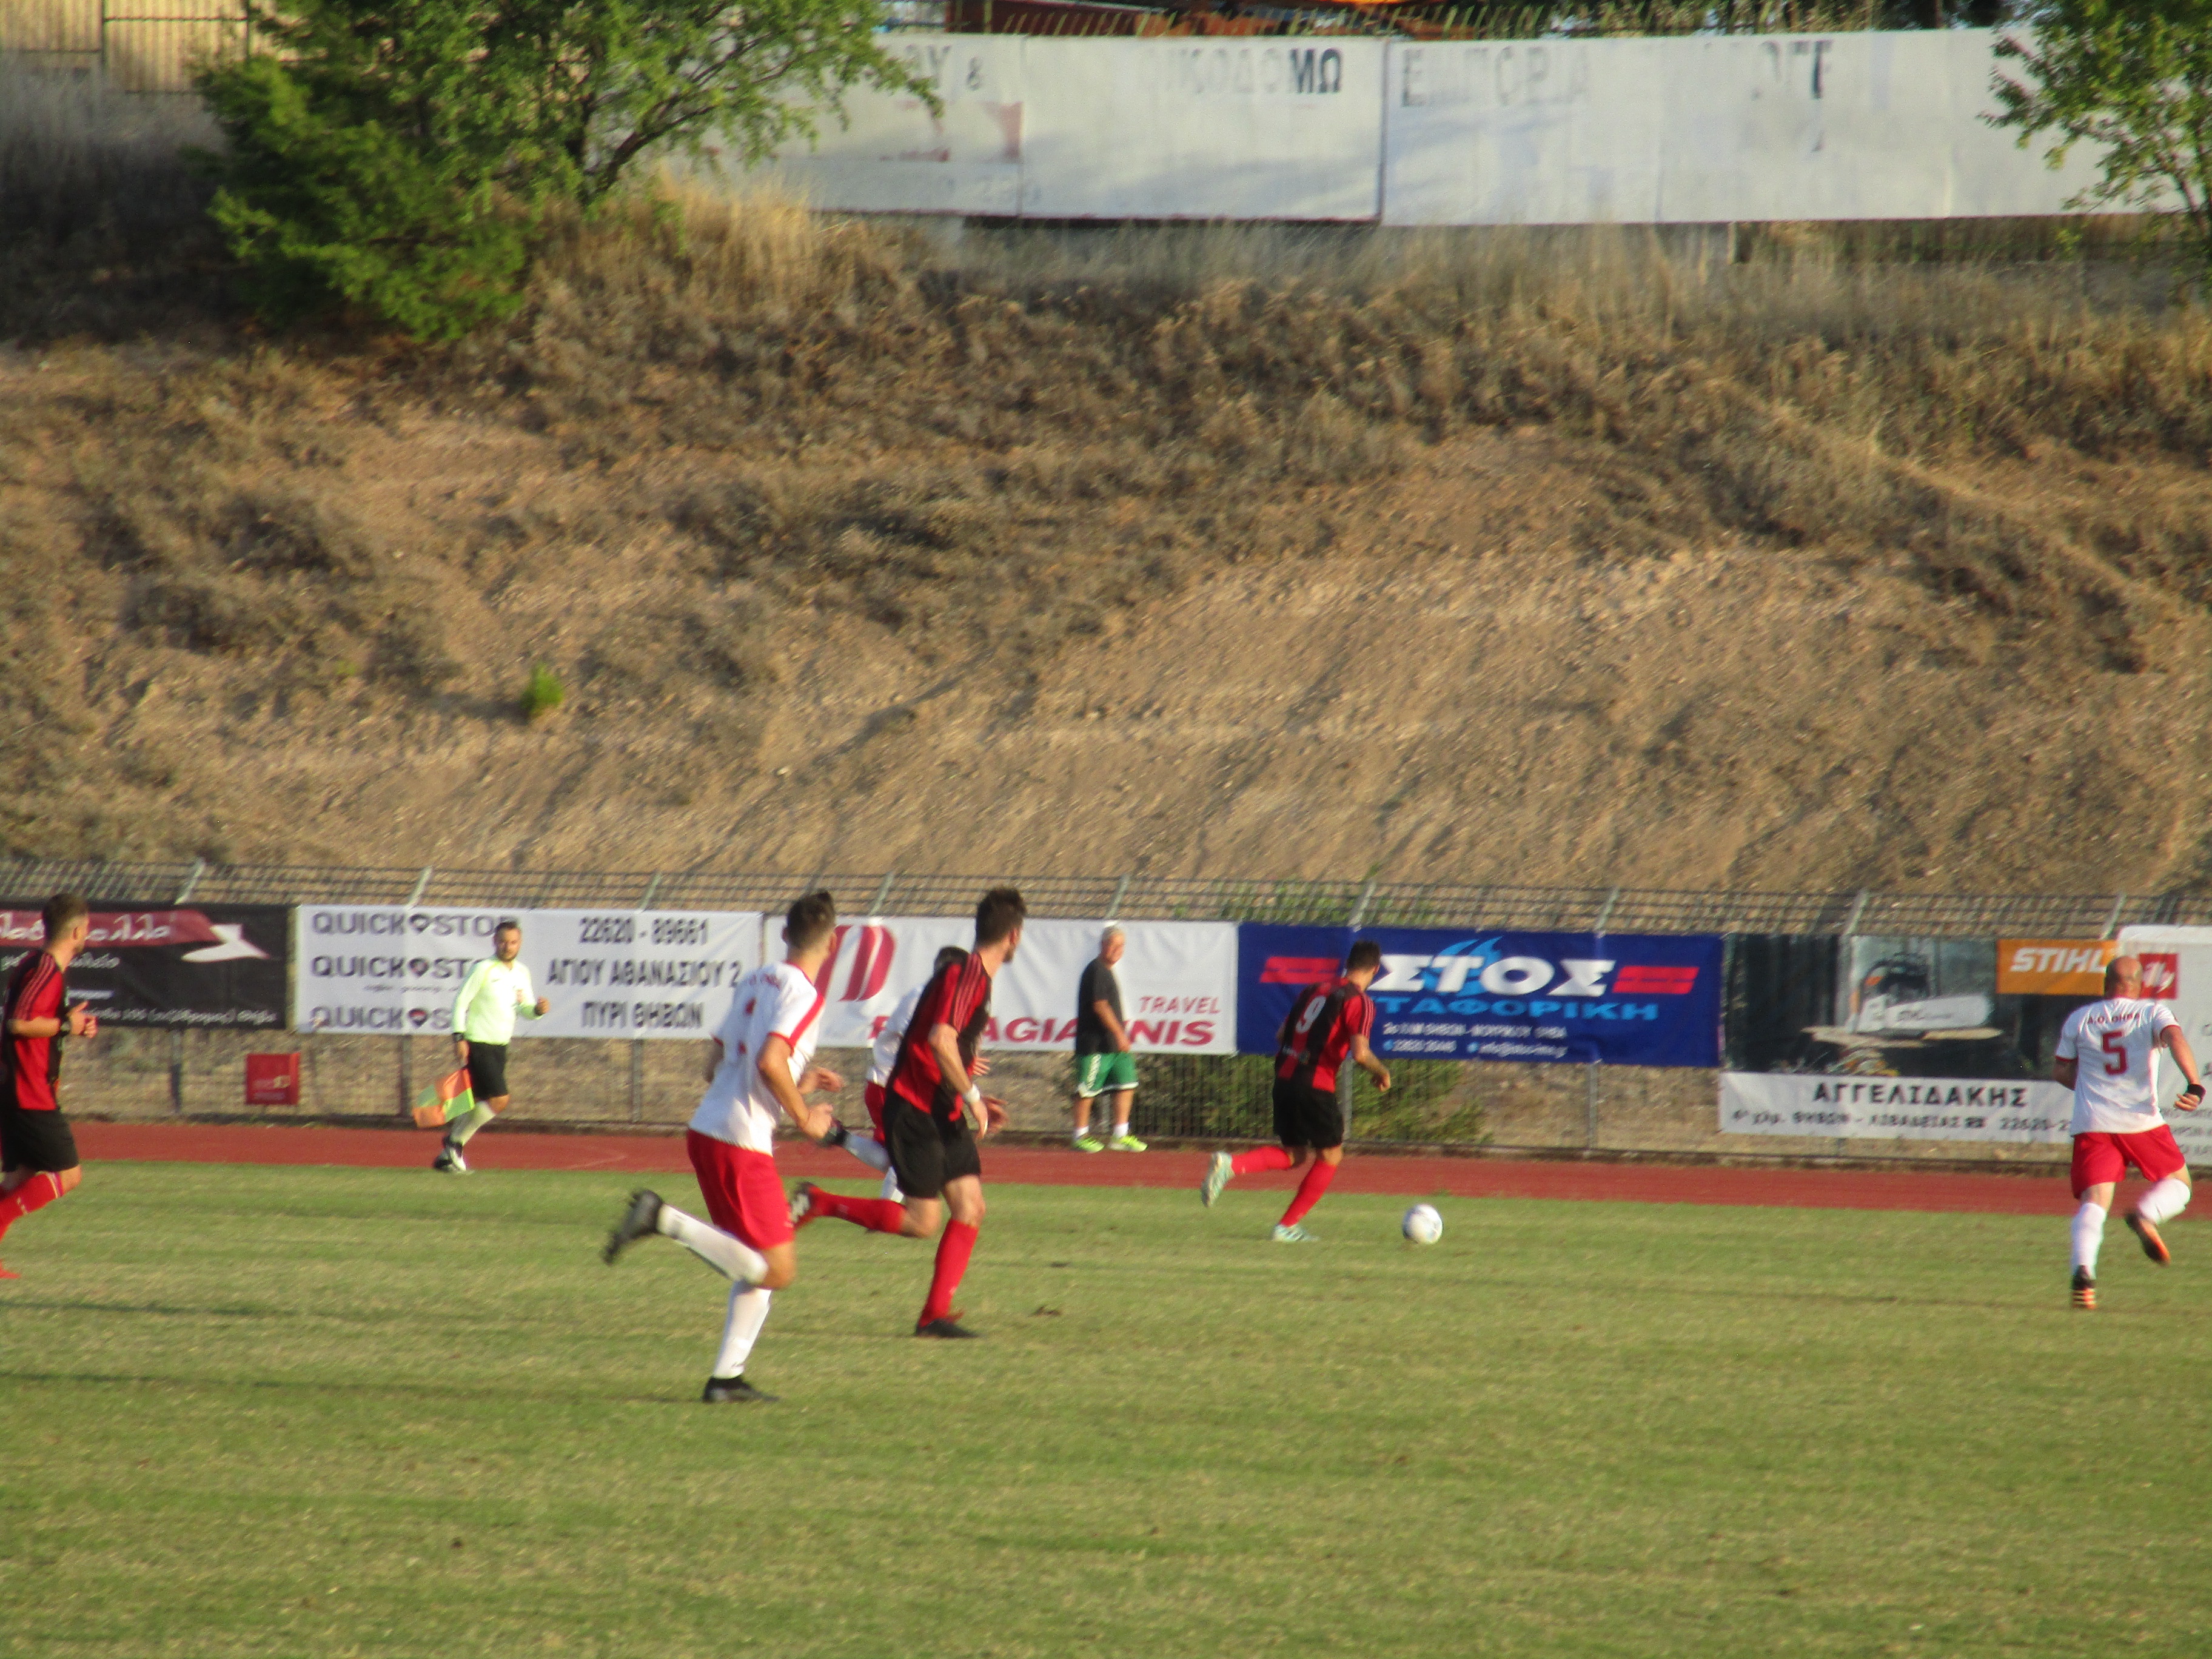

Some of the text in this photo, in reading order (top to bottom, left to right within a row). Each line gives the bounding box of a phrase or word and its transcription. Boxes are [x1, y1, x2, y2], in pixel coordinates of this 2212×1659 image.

[311, 911, 406, 936] QUICK
[579, 917, 635, 944] 22620
[310, 955, 406, 979] QUICK
[547, 957, 606, 987] ΑΓΙΟΥ
[609, 958, 725, 988] ΑΘΑΝΑΣΙΟΥ
[729, 960, 743, 988] 2
[2009, 947, 2106, 973] STIHL
[581, 1000, 706, 1030] ΠΥΡΙ ΘΗΒΩΝ
[1138, 994, 1221, 1014] TRAVEL
[1295, 995, 1327, 1034] 9
[1372, 996, 1659, 1021] ΤΑΦΟΡΙΚΗ
[310, 1006, 404, 1029] QUICK
[2102, 1031, 2128, 1076] 5
[1812, 1082, 2028, 1108] ΑΓΓΕΛΙΔΑΚΗΣ
